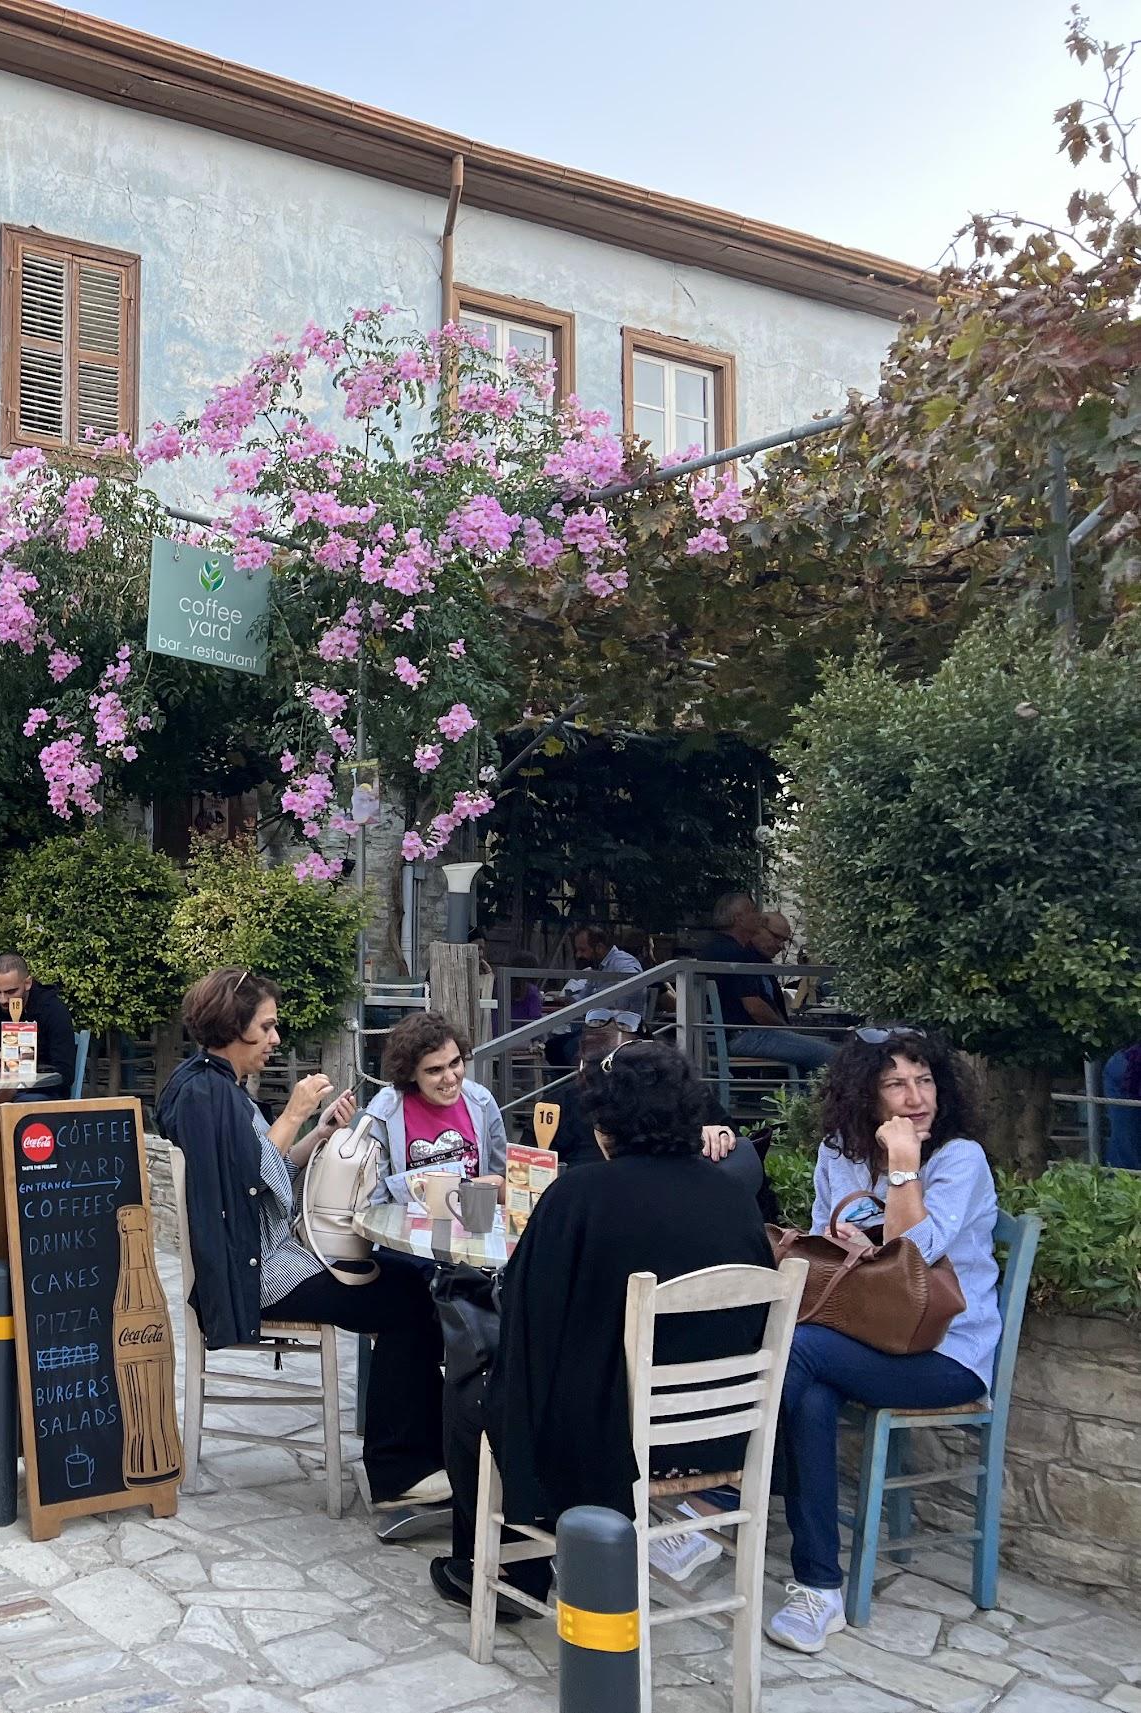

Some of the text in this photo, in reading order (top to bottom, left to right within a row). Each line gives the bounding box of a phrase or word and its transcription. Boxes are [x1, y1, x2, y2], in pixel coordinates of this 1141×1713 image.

[179, 597, 243, 625] coffee
[188, 618, 232, 641] yard
[158, 634, 181, 651] bar
[192, 645, 258, 669] restaurant
[539, 1110, 553, 1126] 16
[23, 1135, 52, 1149] Coca-Cola
[56, 1120, 131, 1148] COFFEE
[65, 1156, 125, 1180] YARD
[19, 1180, 72, 1194] ENTRANCE
[24, 1193, 115, 1219] COFFEES
[29, 1227, 97, 1256] DRINKS
[31, 1266, 101, 1295] CAKES
[35, 1307, 102, 1335] PIZZA
[118, 1323, 165, 1347] Coca-Cola
[36, 1376, 109, 1407] BURGERS
[39, 1404, 117, 1439] SALADS
